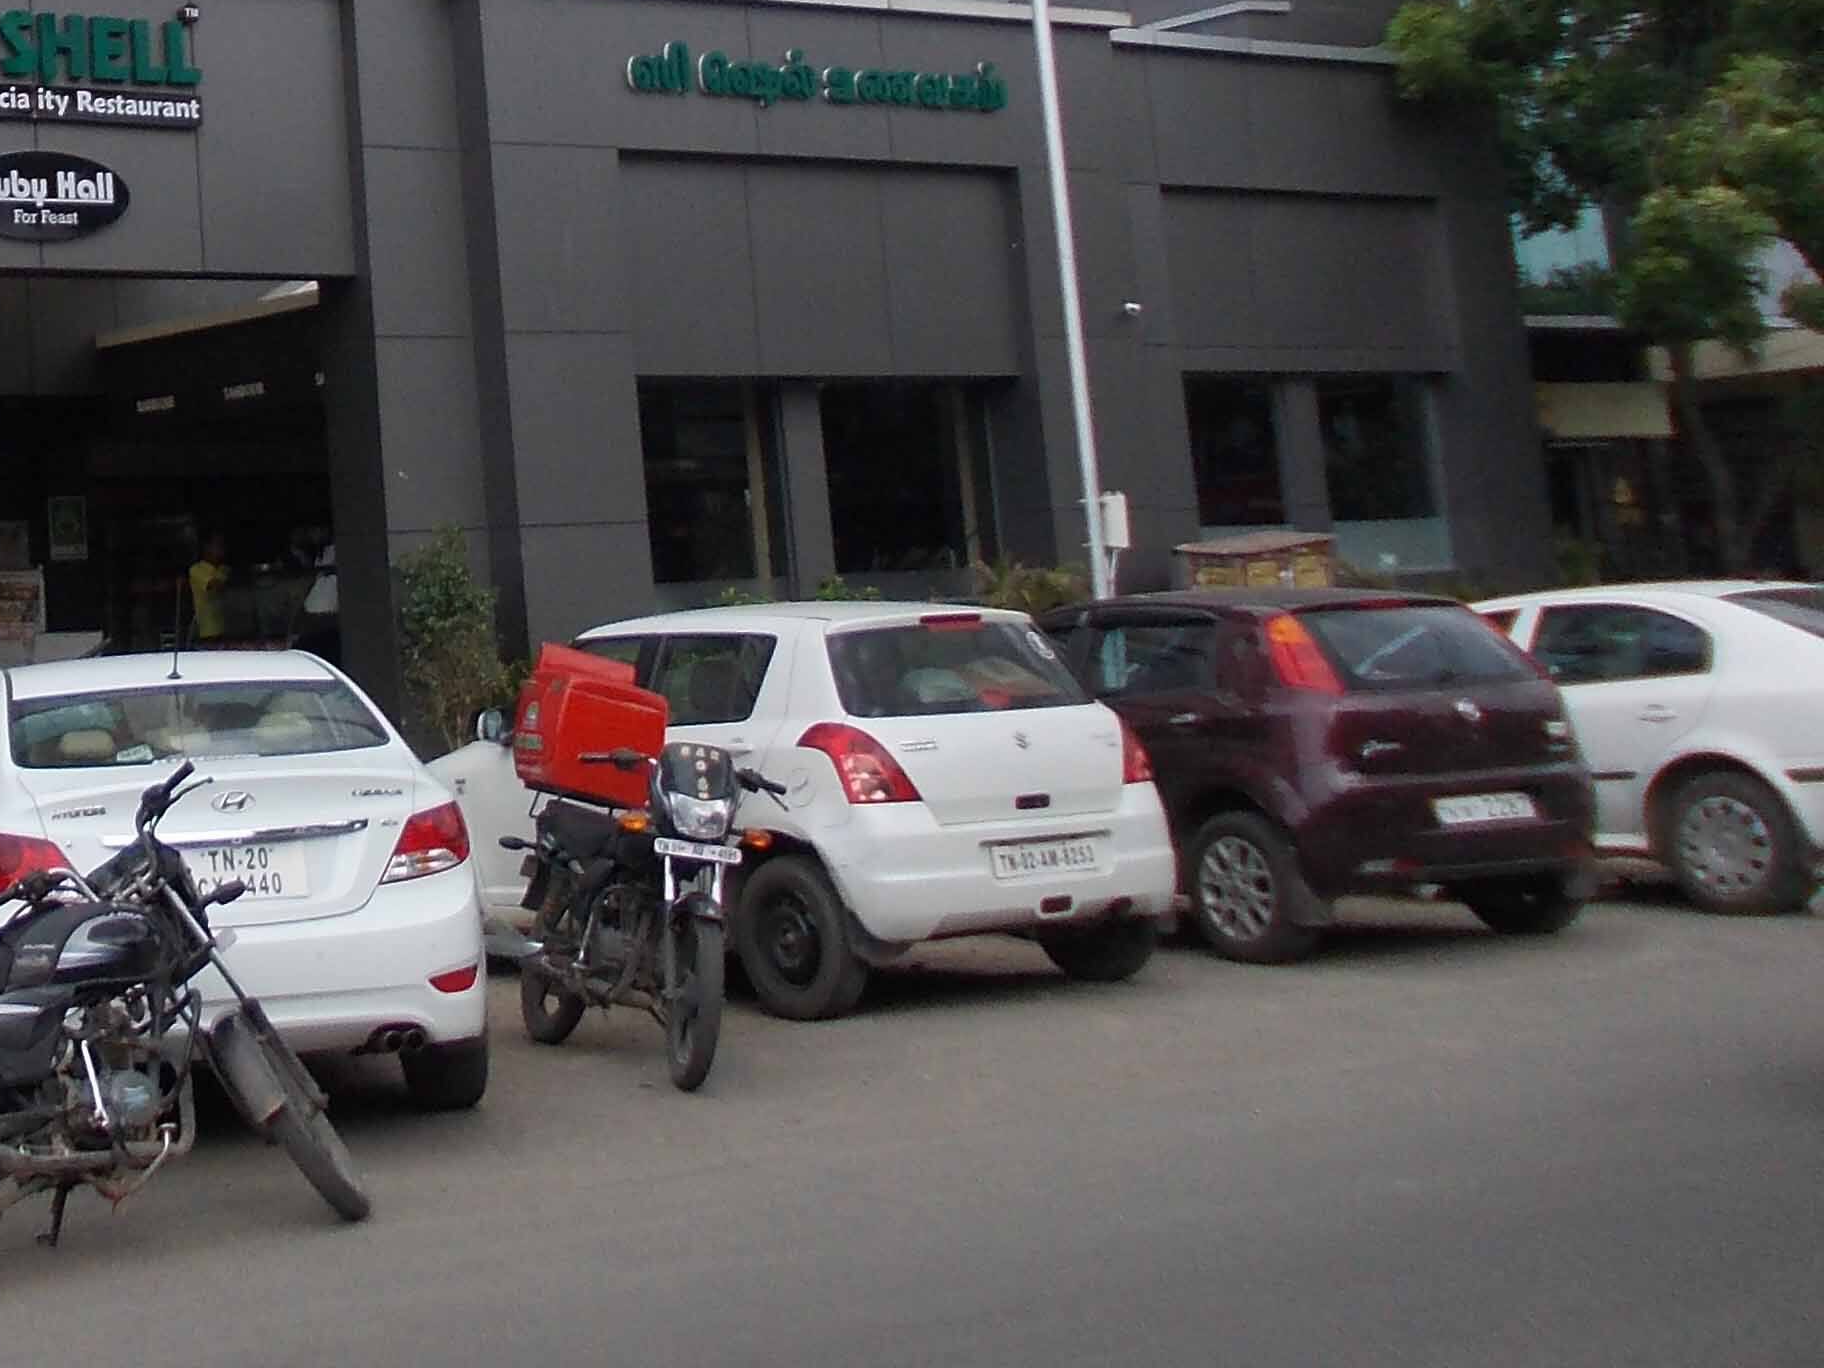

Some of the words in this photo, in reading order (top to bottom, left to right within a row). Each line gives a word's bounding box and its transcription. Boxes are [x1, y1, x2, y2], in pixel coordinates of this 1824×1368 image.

[77, 89, 201, 120] Restaurant
[56, 169, 115, 204] Hall
[13, 209, 37, 225] For
[41, 209, 79, 225] Feast
[235, 872, 282, 897] 440
